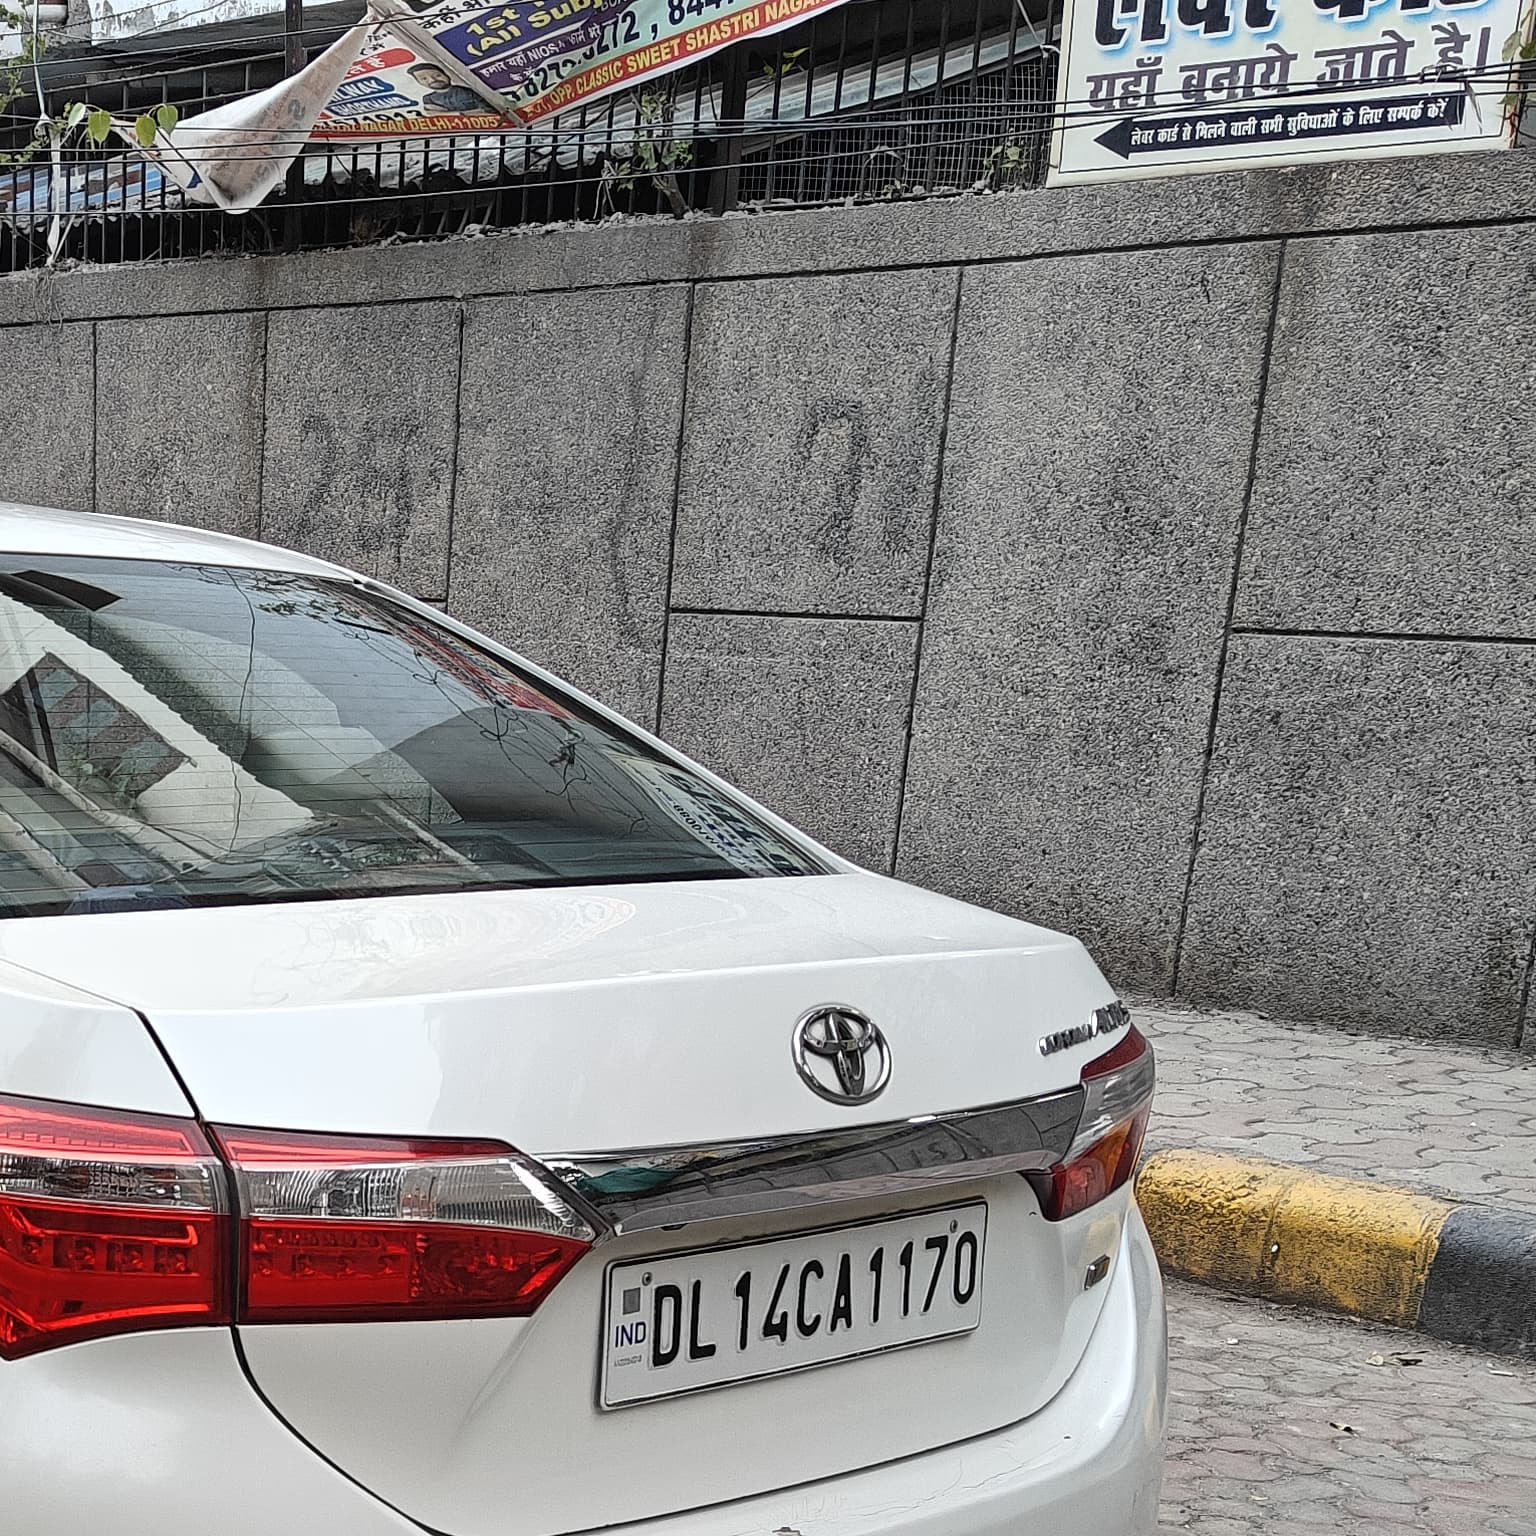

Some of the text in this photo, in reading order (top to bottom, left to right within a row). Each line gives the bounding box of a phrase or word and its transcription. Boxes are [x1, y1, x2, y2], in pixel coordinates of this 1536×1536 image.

[575, 60, 624, 94] CLASSIC
[626, 38, 682, 73] SWEET
[685, 13, 760, 51] SHASTRI
[1086, 56, 1163, 110] यहाँ
[1179, 43, 1298, 103] बनाये
[1314, 29, 1415, 88] जाते
[615, 1321, 647, 1348] IND
